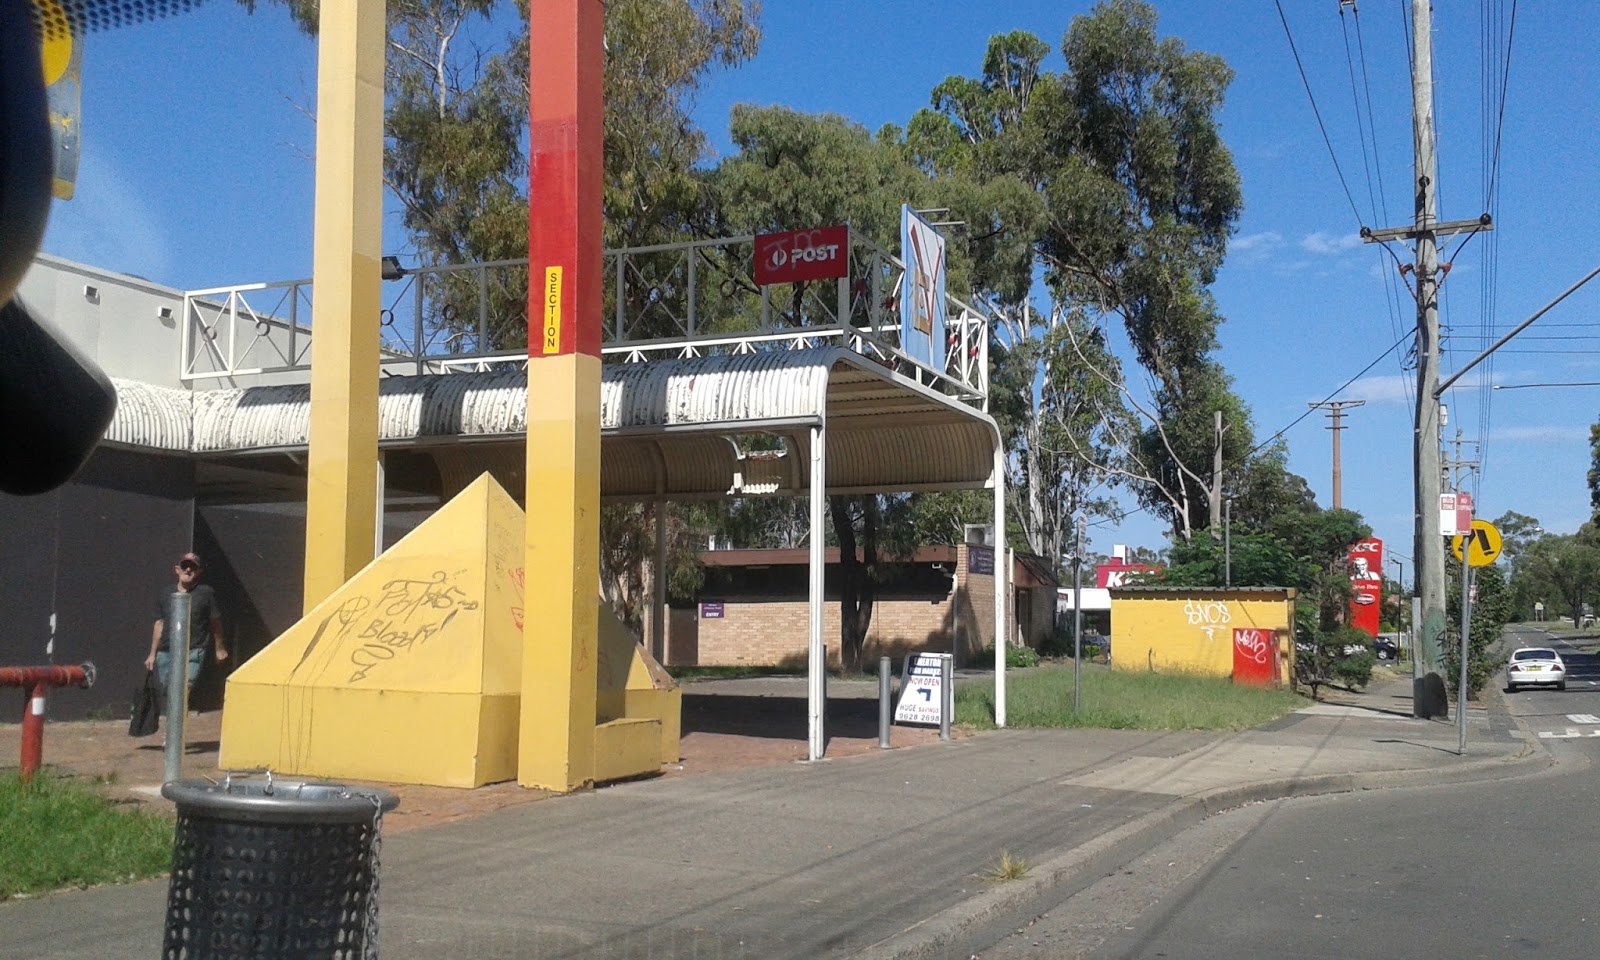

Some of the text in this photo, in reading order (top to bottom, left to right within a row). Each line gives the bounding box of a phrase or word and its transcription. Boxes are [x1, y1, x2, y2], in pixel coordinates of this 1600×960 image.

[791, 244, 839, 264] POST
[547, 272, 557, 348] SECTION
[924, 678, 940, 686] OPEN
[900, 704, 939, 714] HUGE SAVINGS
